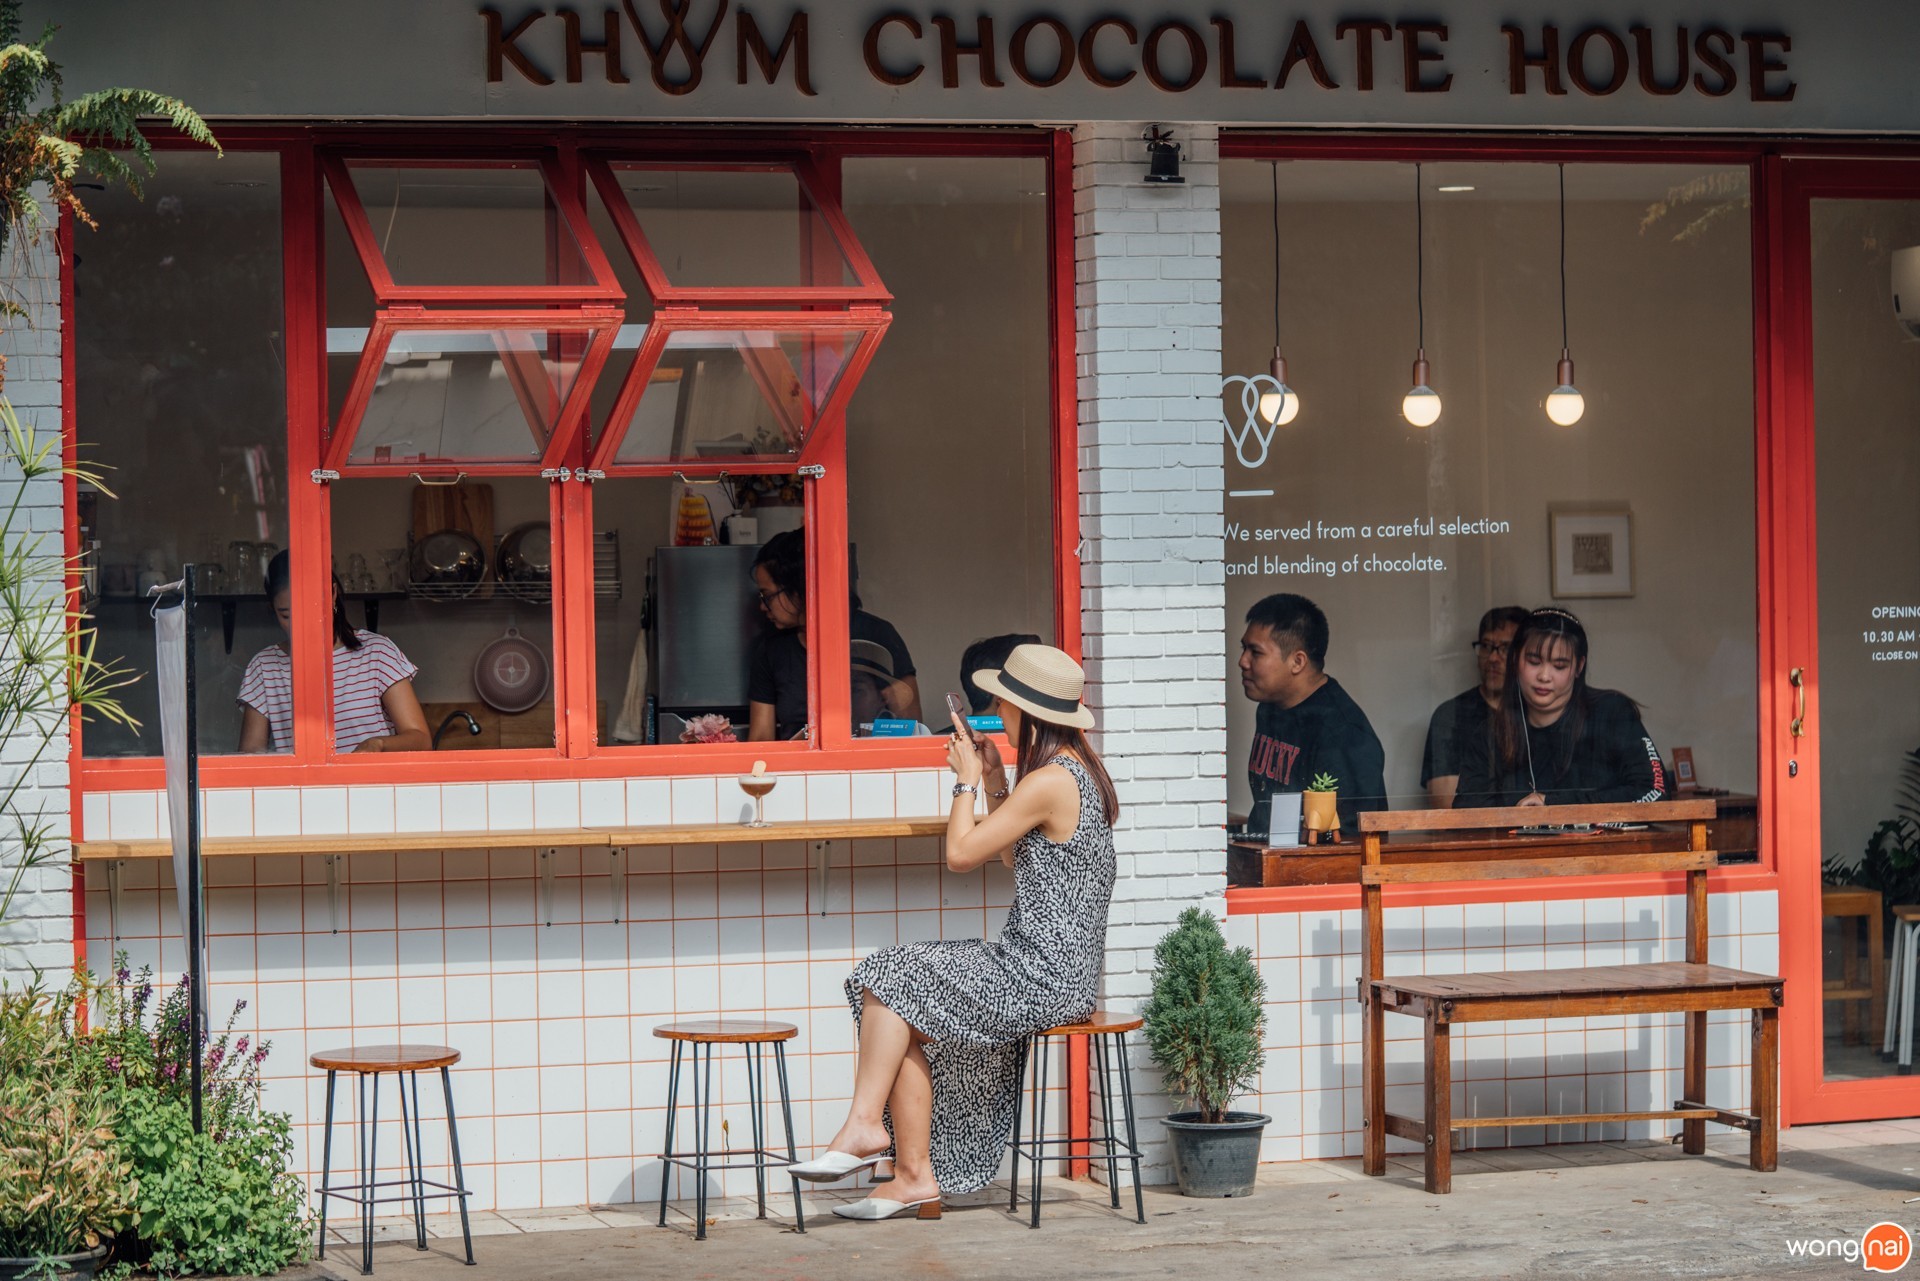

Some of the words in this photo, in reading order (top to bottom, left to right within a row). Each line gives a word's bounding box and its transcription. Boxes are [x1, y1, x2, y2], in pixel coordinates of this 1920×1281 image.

[862, 15, 1454, 93] CHOCOLATE
[1501, 25, 1797, 102] HOUSE
[1223, 522, 1250, 541] We
[1255, 520, 1311, 541] served
[1316, 520, 1356, 540] from
[1360, 526, 1372, 538] a
[1377, 516, 1434, 538] careful
[1439, 515, 1510, 536] selection
[1226, 555, 1258, 576] and
[1264, 553, 1336, 578] blending
[1341, 553, 1359, 573] of
[1363, 551, 1447, 573] chocolate.
[1862, 630, 1895, 643] 10.30
[1896, 629, 1916, 643] AM
[1904, 650, 1919, 661] ON
[1248, 732, 1301, 786] LUCKY
